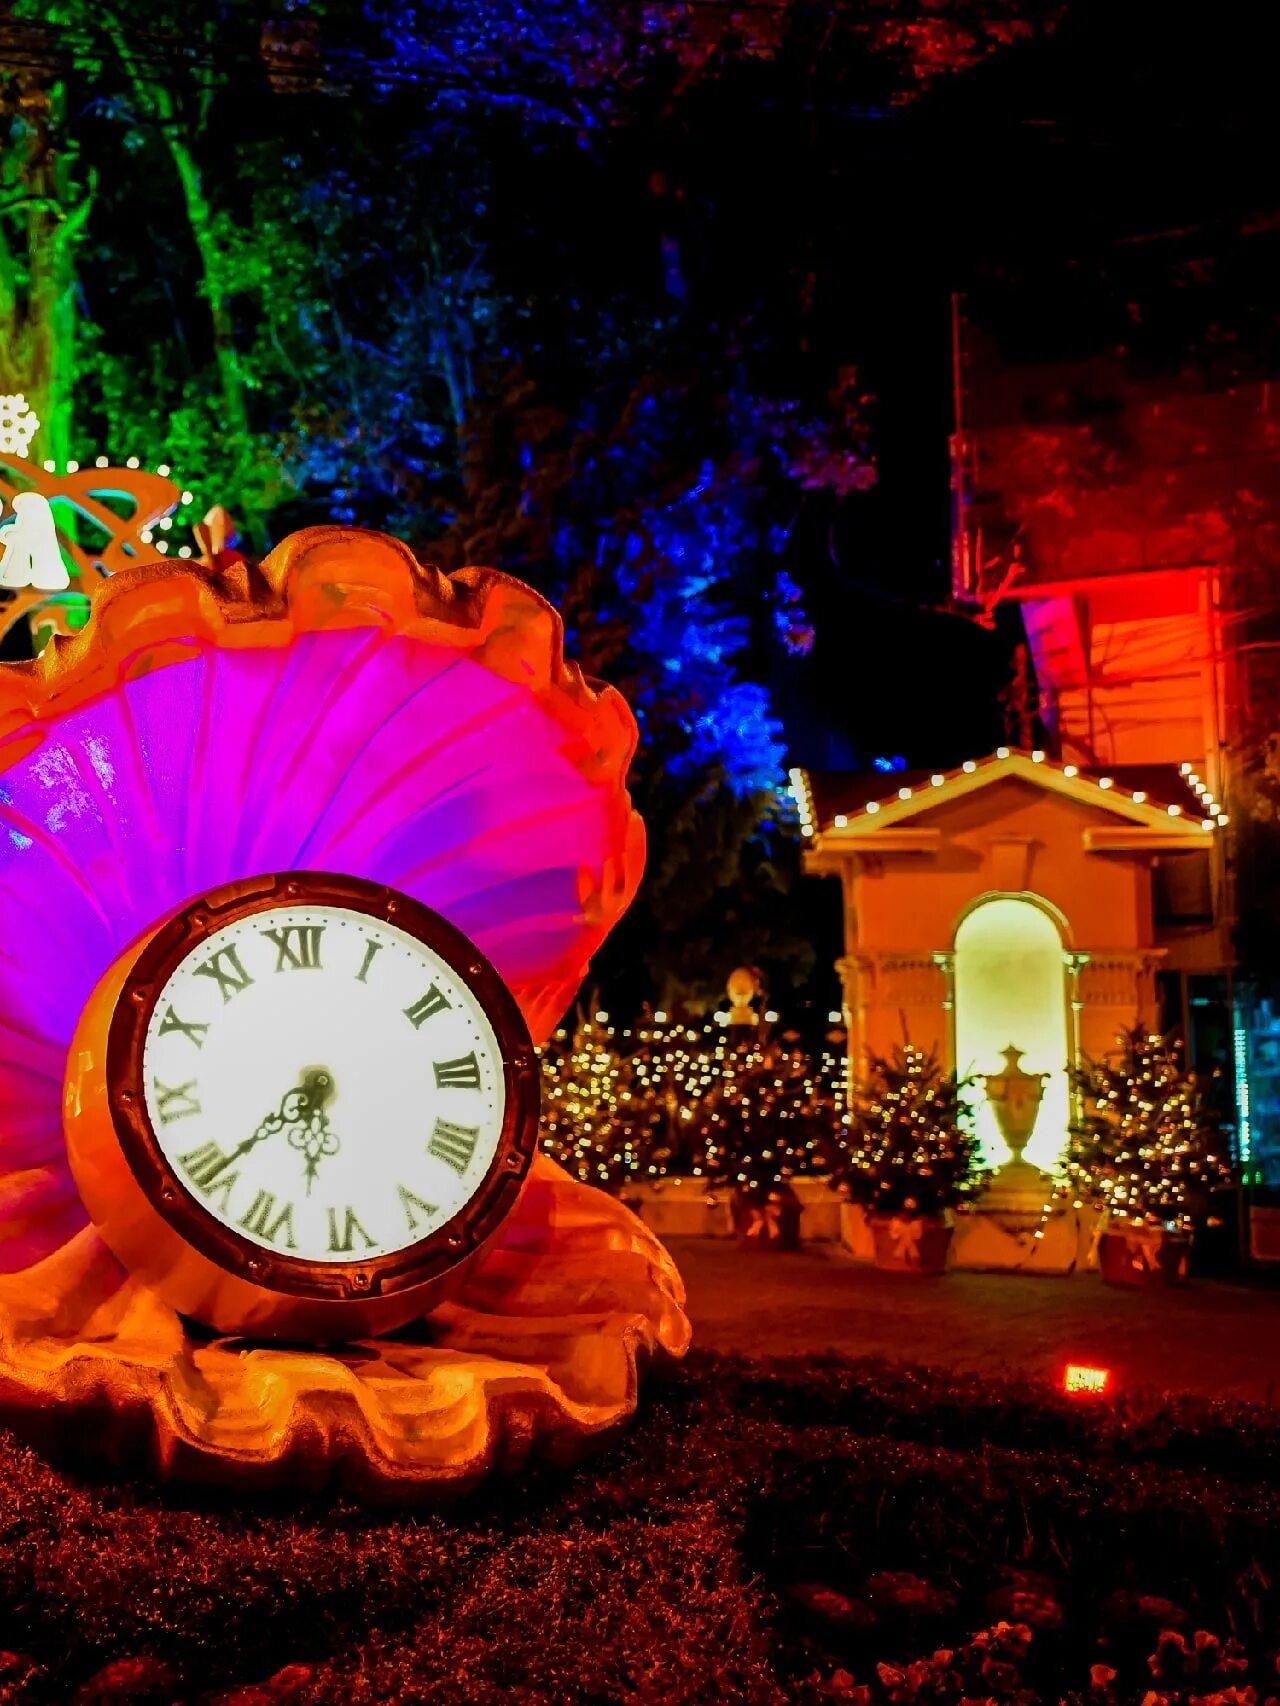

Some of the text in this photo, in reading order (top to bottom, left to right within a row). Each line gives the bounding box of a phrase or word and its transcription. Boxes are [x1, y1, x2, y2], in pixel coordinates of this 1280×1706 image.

[260, 926, 326, 972] XII
[354, 939, 383, 984] I
[192, 943, 255, 1005] XI
[158, 1004, 210, 1049] X
[402, 983, 452, 1030] II
[432, 1051, 482, 1093] III
[153, 1076, 202, 1126] IX
[426, 1117, 480, 1178] IIII
[237, 1189, 297, 1249] VII
[326, 1206, 379, 1253] VI
[396, 1184, 439, 1230] V
